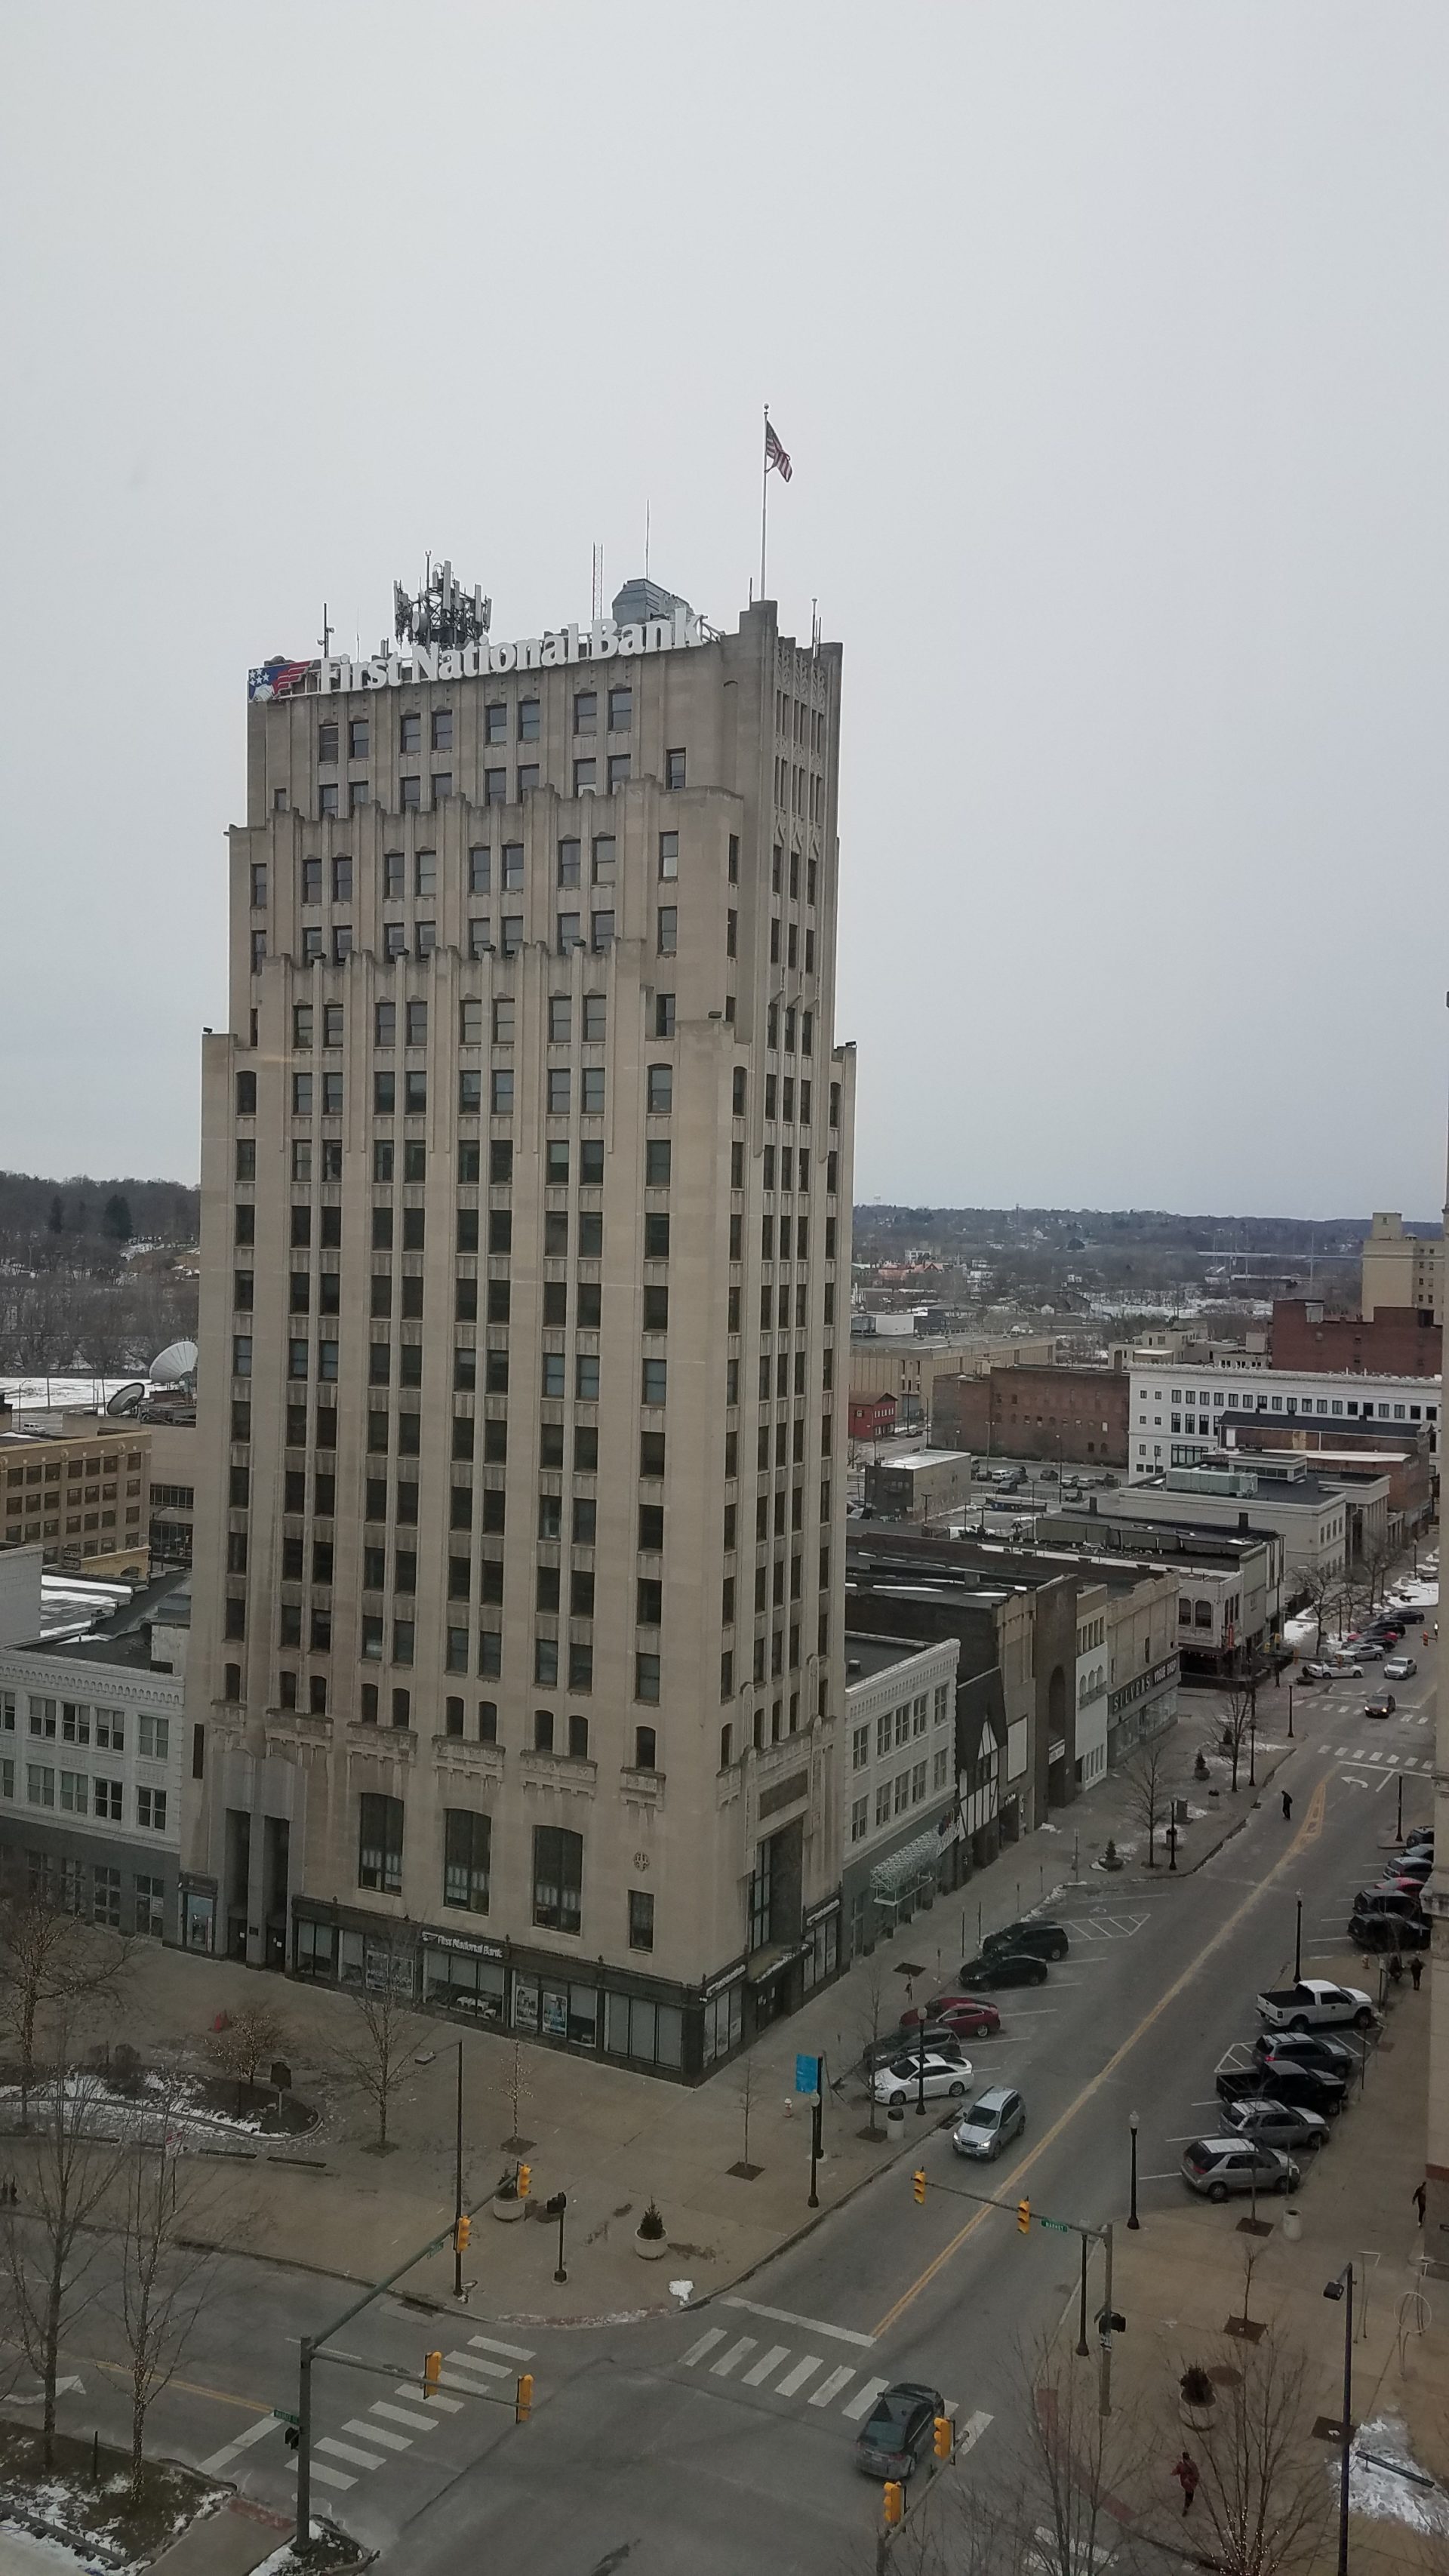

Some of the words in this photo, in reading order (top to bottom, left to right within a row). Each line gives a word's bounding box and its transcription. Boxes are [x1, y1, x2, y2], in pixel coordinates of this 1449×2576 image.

[321, 652, 401, 694] First
[412, 623, 580, 684] National
[591, 608, 705, 660] Bank
[1113, 1675, 1150, 1712] SILVERS
[437, 1934, 453, 1947] First
[453, 1937, 483, 1954] National
[483, 1944, 503, 1959] Bank
